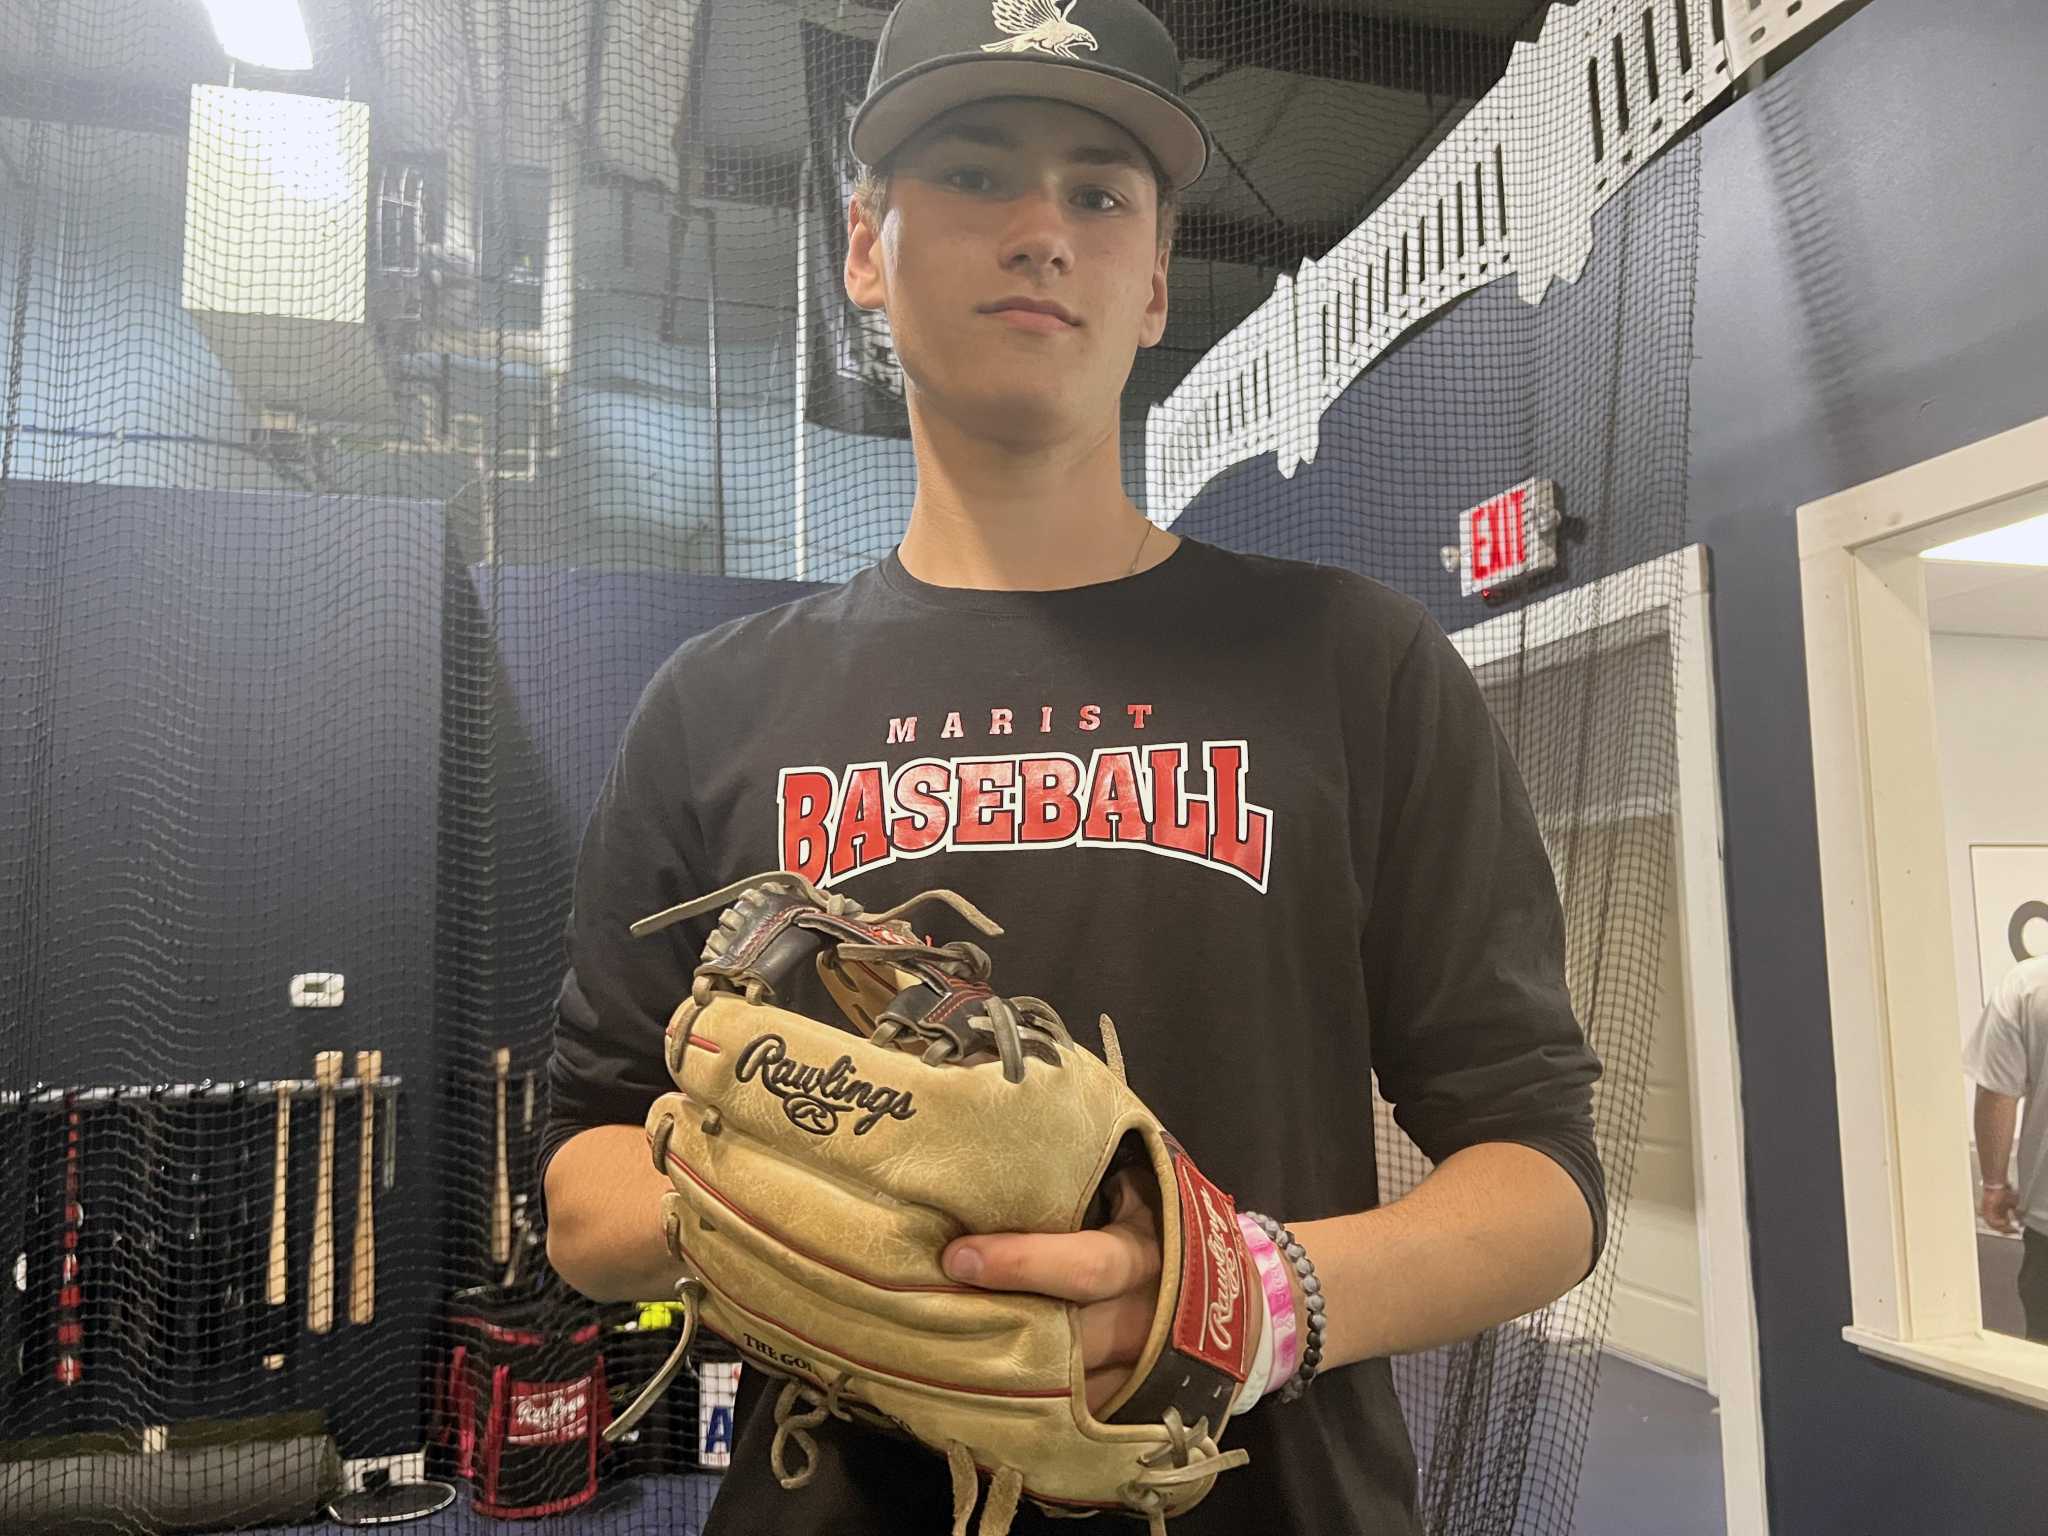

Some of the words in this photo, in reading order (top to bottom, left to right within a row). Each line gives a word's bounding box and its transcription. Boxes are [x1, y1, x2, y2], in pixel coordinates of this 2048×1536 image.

[886, 704, 1152, 744] MARIST
[777, 740, 1273, 894] BASEBALL
[735, 1033, 918, 1136] Rawlings
[1201, 1186, 1240, 1351] Rawlings
[743, 1332, 778, 1360] THE
